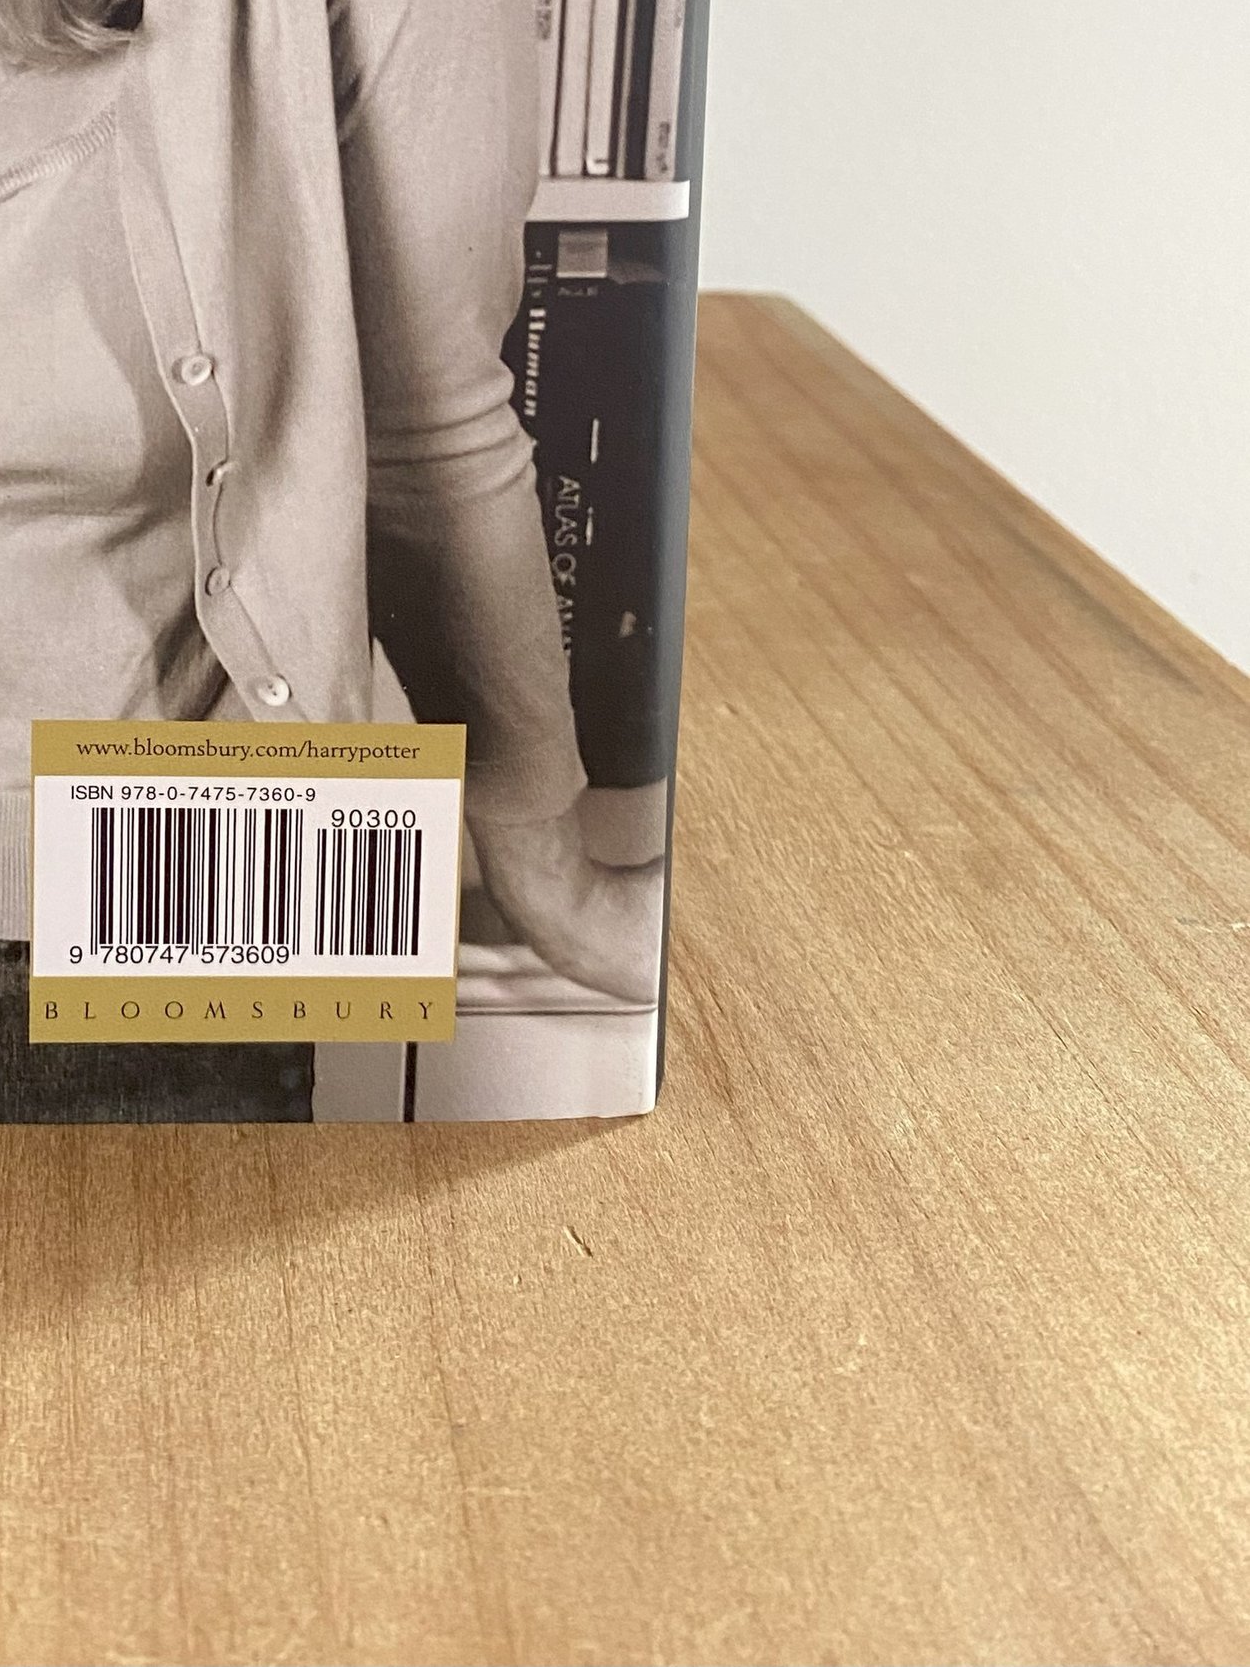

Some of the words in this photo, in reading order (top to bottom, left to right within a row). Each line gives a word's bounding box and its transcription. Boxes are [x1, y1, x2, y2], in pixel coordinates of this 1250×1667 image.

[523, 307, 547, 417] Human
[554, 475, 582, 547] ATLAS
[75, 737, 421, 764] www.bloomsbury.com/harrypotter
[70, 784, 114, 802] ISBN
[120, 785, 317, 803] 978-0-7475-7360-9
[331, 809, 417, 829] 90300
[69, 945, 84, 964] 9
[99, 944, 190, 965] 780747
[200, 944, 291, 965] 573609
[44, 999, 434, 1021] BLOOMSBURY
